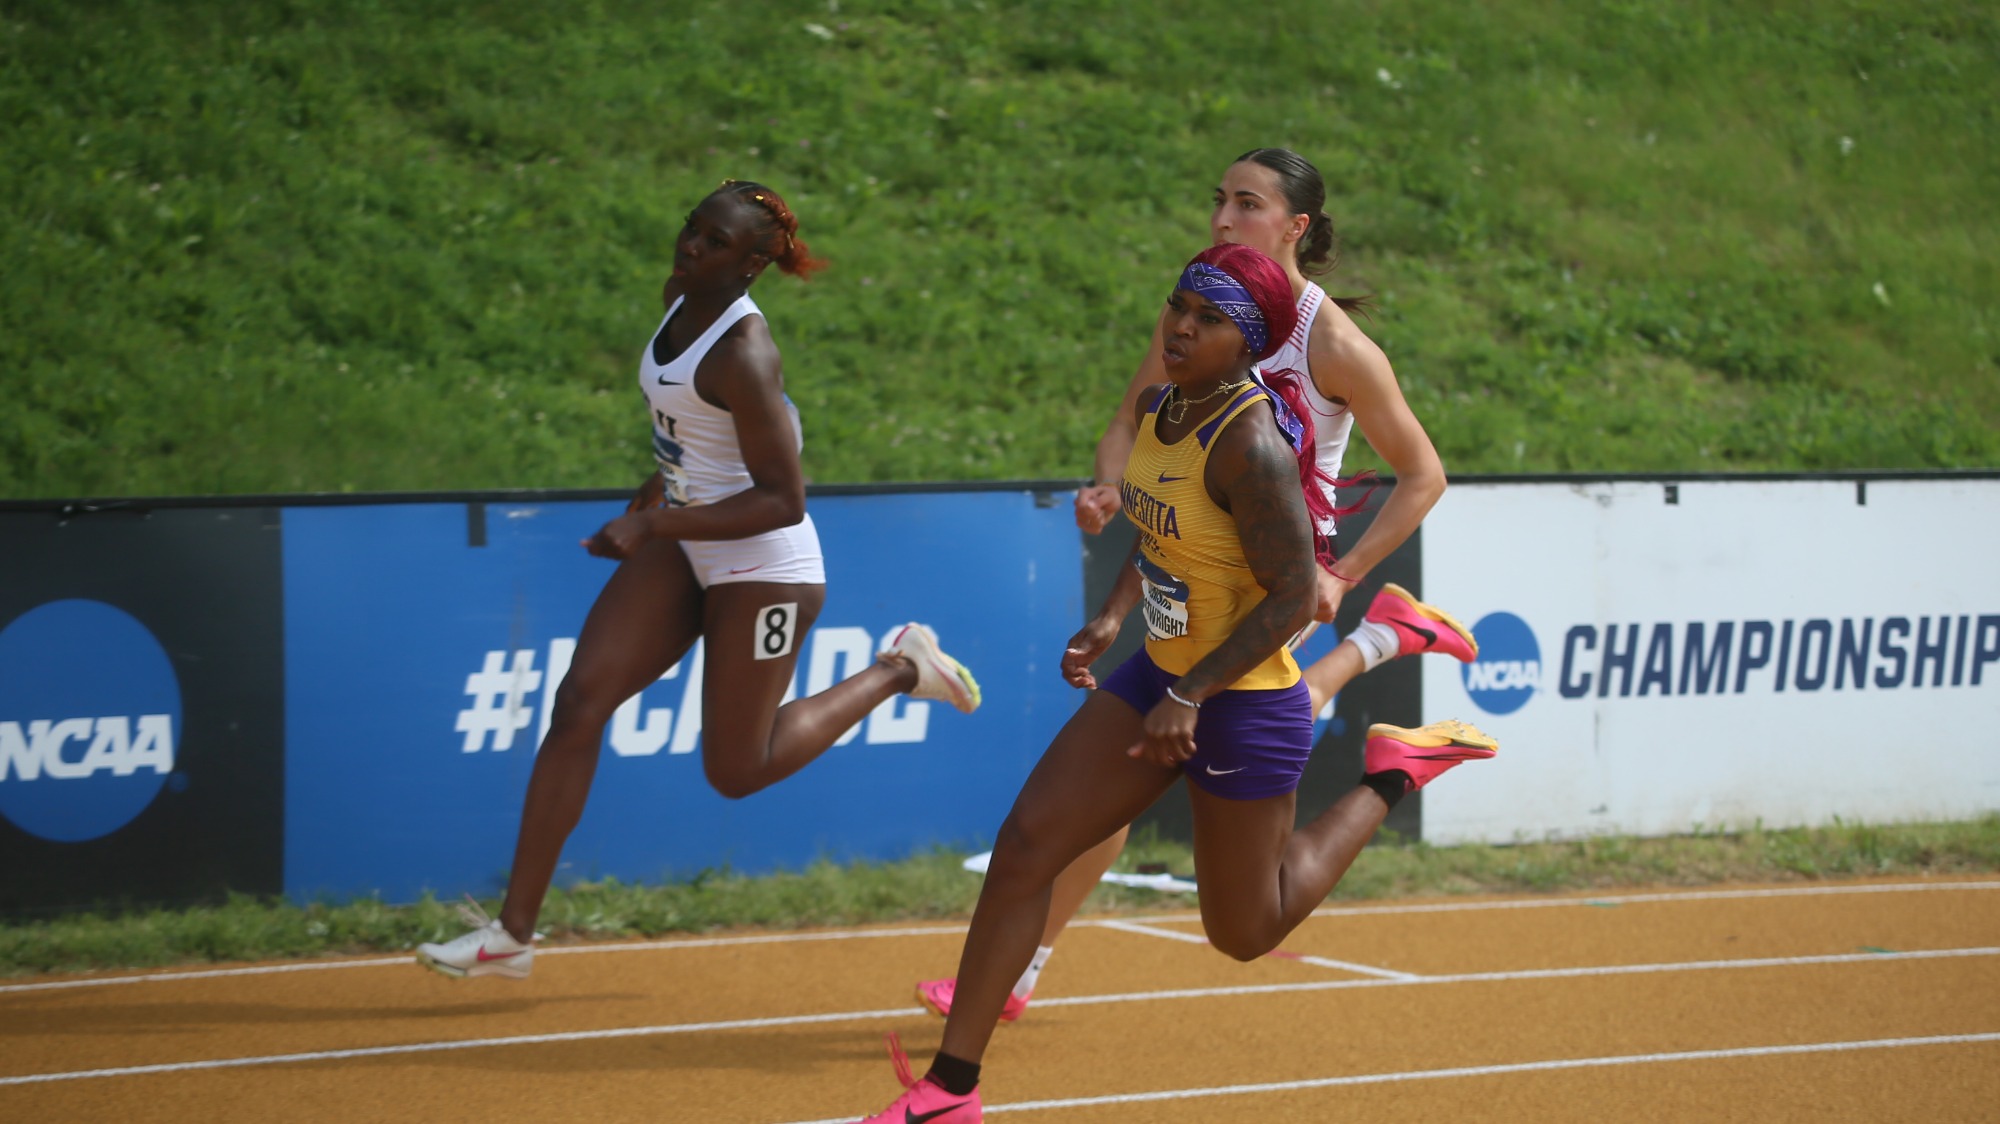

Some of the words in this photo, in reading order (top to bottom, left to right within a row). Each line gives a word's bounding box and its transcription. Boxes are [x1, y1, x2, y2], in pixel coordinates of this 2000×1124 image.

[764, 607, 787, 655] 8
[1468, 660, 1541, 691] NCAA
[1558, 614, 2000, 699] CHAMPIONSHIP
[0, 714, 175, 782] NCAA
